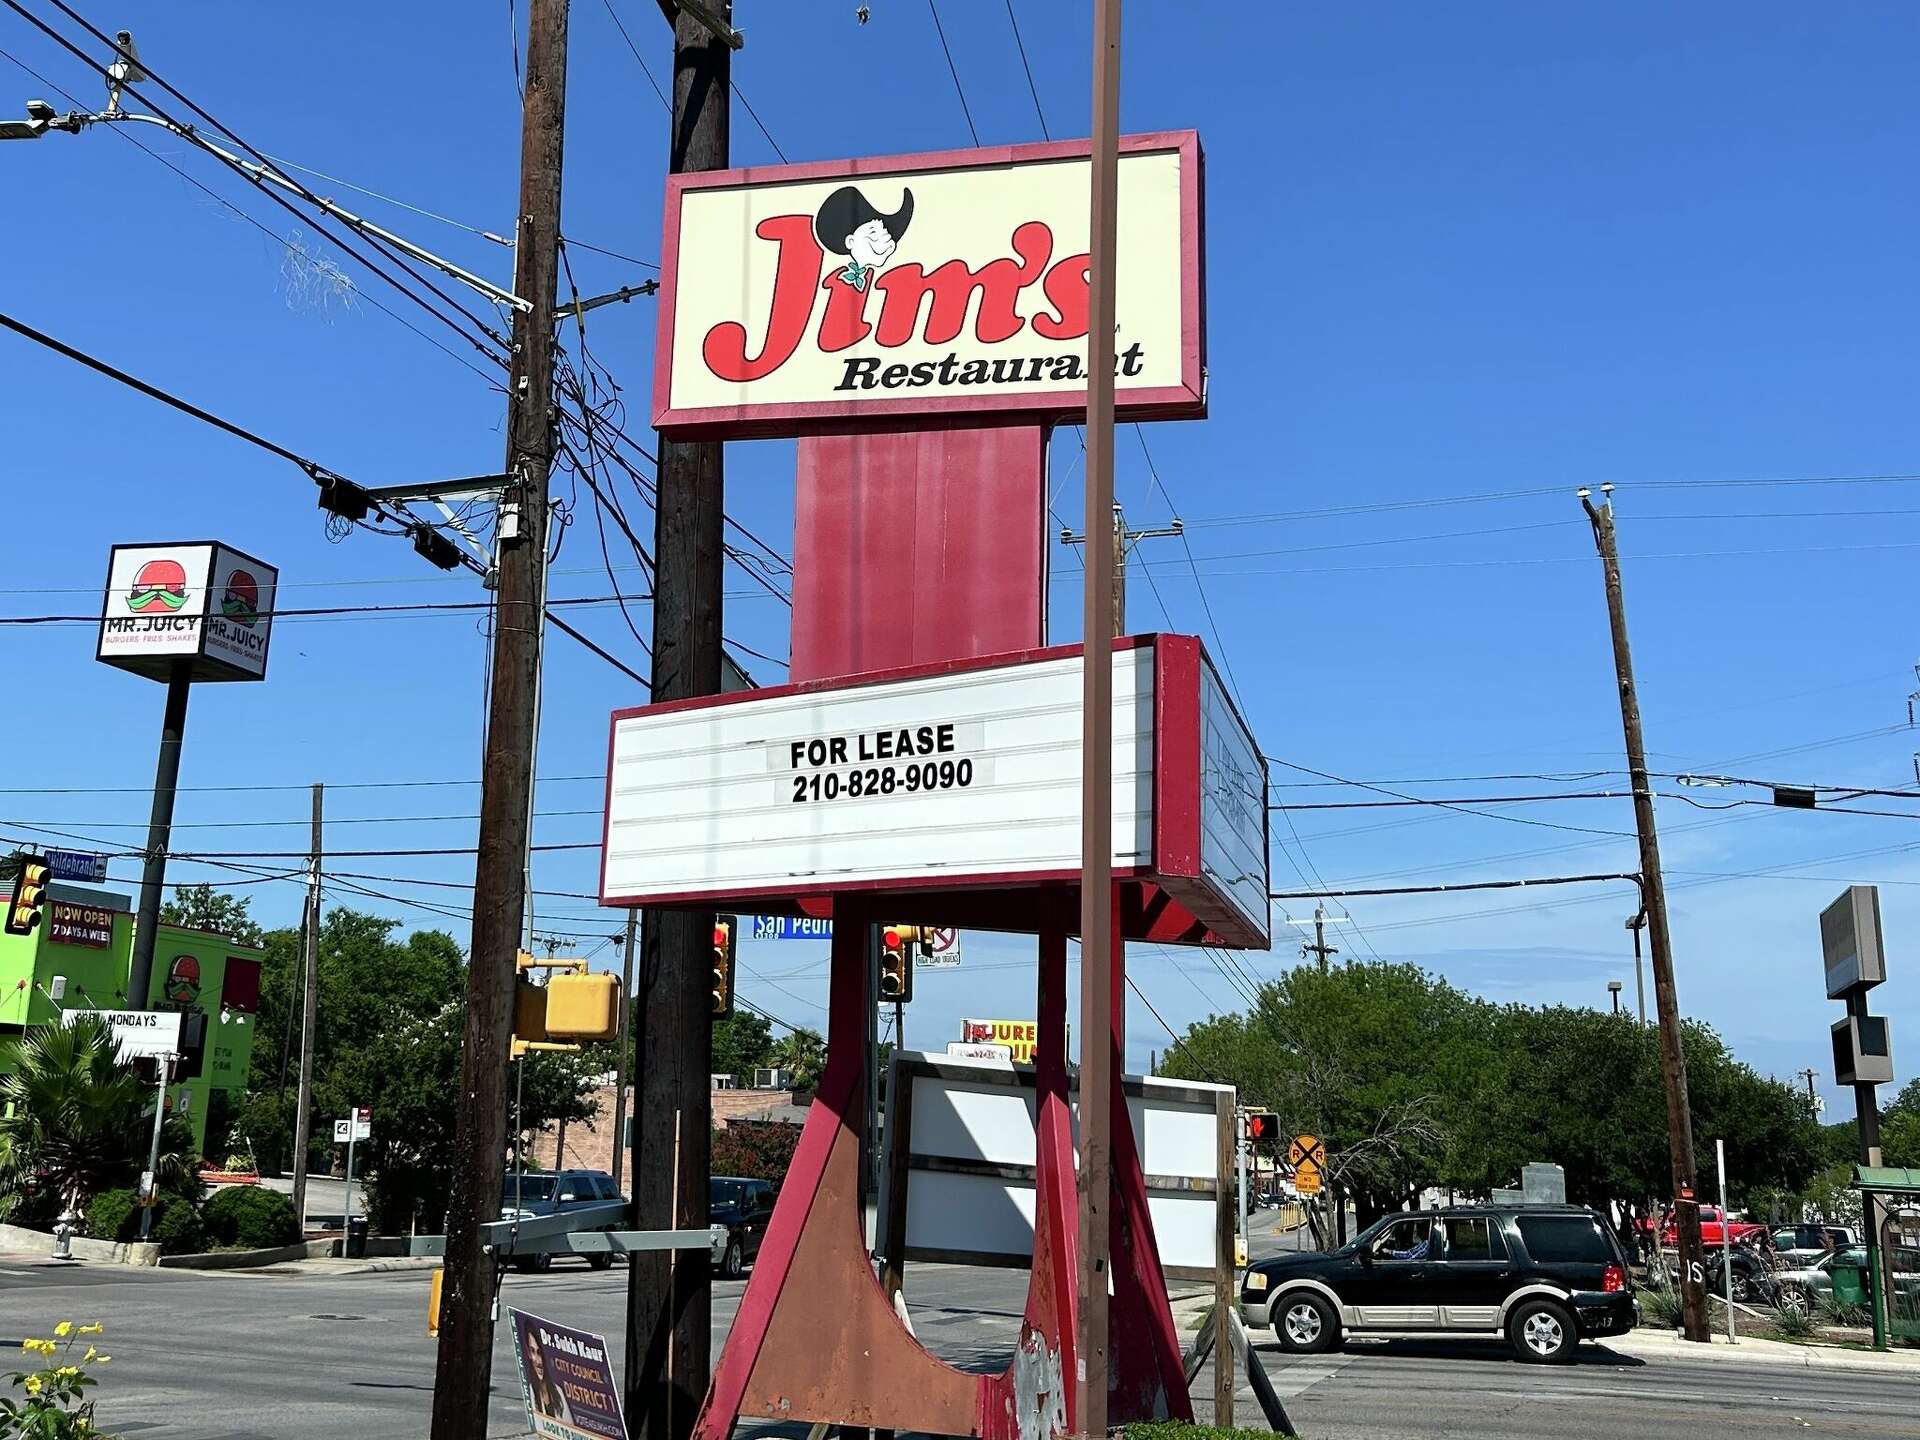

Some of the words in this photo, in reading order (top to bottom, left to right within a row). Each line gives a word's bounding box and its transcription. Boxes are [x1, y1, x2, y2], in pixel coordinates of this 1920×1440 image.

[703, 214, 1091, 382] Jim's
[791, 737, 848, 768] FOR
[859, 724, 954, 761] LEASE
[793, 758, 973, 802] 210-828-9090
[55, 905, 82, 921] NOW
[84, 910, 112, 926] OPEN
[757, 915, 785, 934] San
[53, 924, 60, 935] 7
[60, 925, 82, 938] DAYS
[82, 928, 88, 939] A
[108, 1014, 157, 1027] MONDAYS
[1292, 1149, 1300, 1159] R
[1315, 1150, 1323, 1160] R
[570, 1364, 605, 1384] COUNCIL
[564, 1381, 608, 1411] DISTRICT
[609, 1395, 616, 1413] 1
